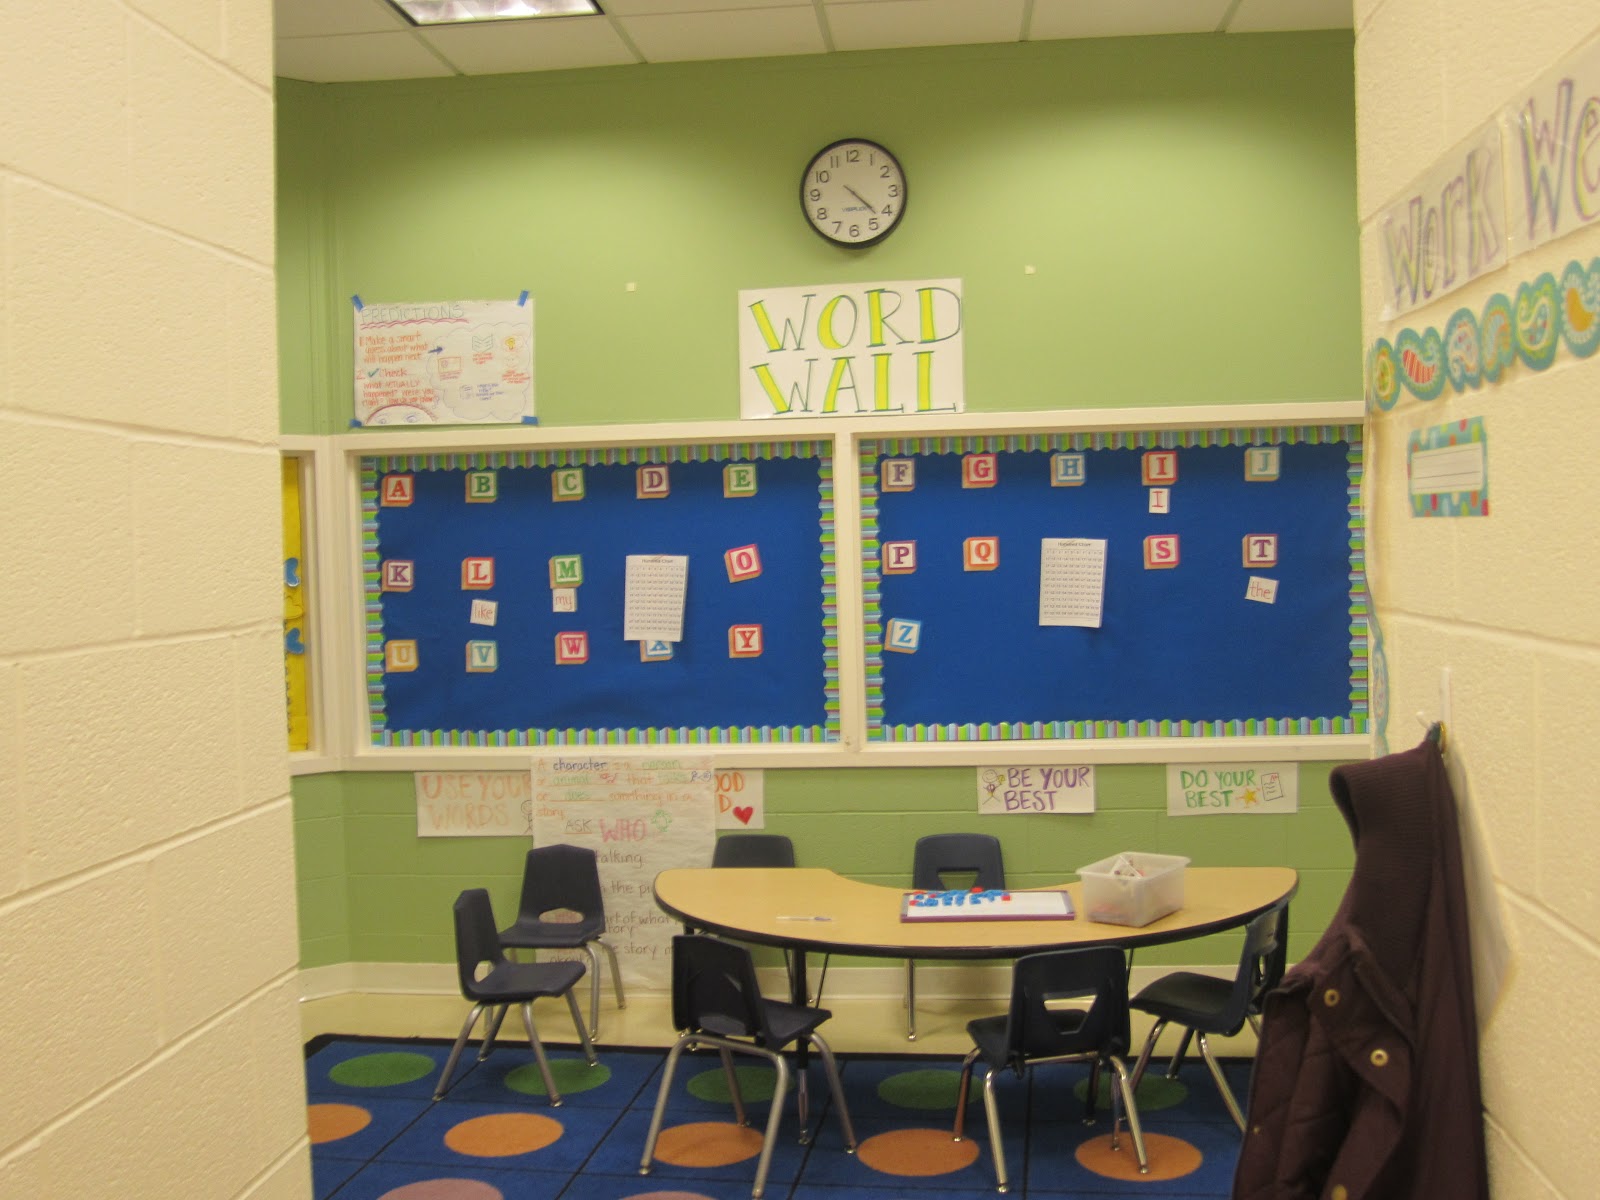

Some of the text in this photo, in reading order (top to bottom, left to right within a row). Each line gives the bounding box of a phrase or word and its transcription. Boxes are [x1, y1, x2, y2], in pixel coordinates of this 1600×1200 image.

[830, 156, 839, 168] 11
[846, 149, 859, 163] 12
[869, 154, 873, 166] 1
[815, 170, 830, 183] 10
[880, 165, 890, 178] 2
[809, 188, 820, 201] 9
[887, 184, 898, 198] 3
[816, 207, 828, 220] 8
[881, 204, 892, 216] 4
[831, 220, 842, 234] 7
[848, 224, 860, 238] 6
[868, 217, 879, 230] 5
[361, 304, 464, 323] PREDICTIONS
[748, 287, 961, 353] WORD
[365, 335, 385, 346] Make
[379, 367, 408, 378] Check
[750, 351, 956, 415] WALL
[973, 459, 990, 478] G
[1060, 458, 1080, 477] H
[1156, 456, 1167, 475] I
[1259, 452, 1271, 472] J
[647, 470, 663, 489] D
[734, 469, 750, 488] E
[892, 463, 908, 482] F
[390, 480, 408, 497] A
[475, 475, 490, 493] B
[563, 473, 577, 491] C
[1152, 490, 1163, 508] I
[893, 546, 910, 564] P
[974, 542, 991, 562] Q
[1155, 540, 1170, 559] S
[1253, 539, 1272, 558] T
[557, 560, 577, 579] M
[736, 551, 753, 570] O
[390, 565, 409, 582] K
[471, 563, 488, 581] L
[1249, 582, 1271, 600] the
[474, 605, 493, 619] like
[555, 596, 573, 610] my
[737, 630, 756, 648] Y
[898, 625, 913, 643] Z
[394, 645, 411, 663] U
[475, 645, 492, 663] V
[563, 637, 583, 655] W
[553, 757, 608, 771] character
[421, 774, 473, 799] USE
[1007, 767, 1090, 788] BE YOUR
[1180, 768, 1256, 790] DO YOUR
[1004, 790, 1057, 811] BEST
[1184, 789, 1233, 809] BEST
[427, 803, 510, 830] WORDS
[565, 817, 647, 842] ASK WHO
[611, 881, 633, 893] the
[622, 911, 636, 924] of
[623, 943, 658, 960] story
